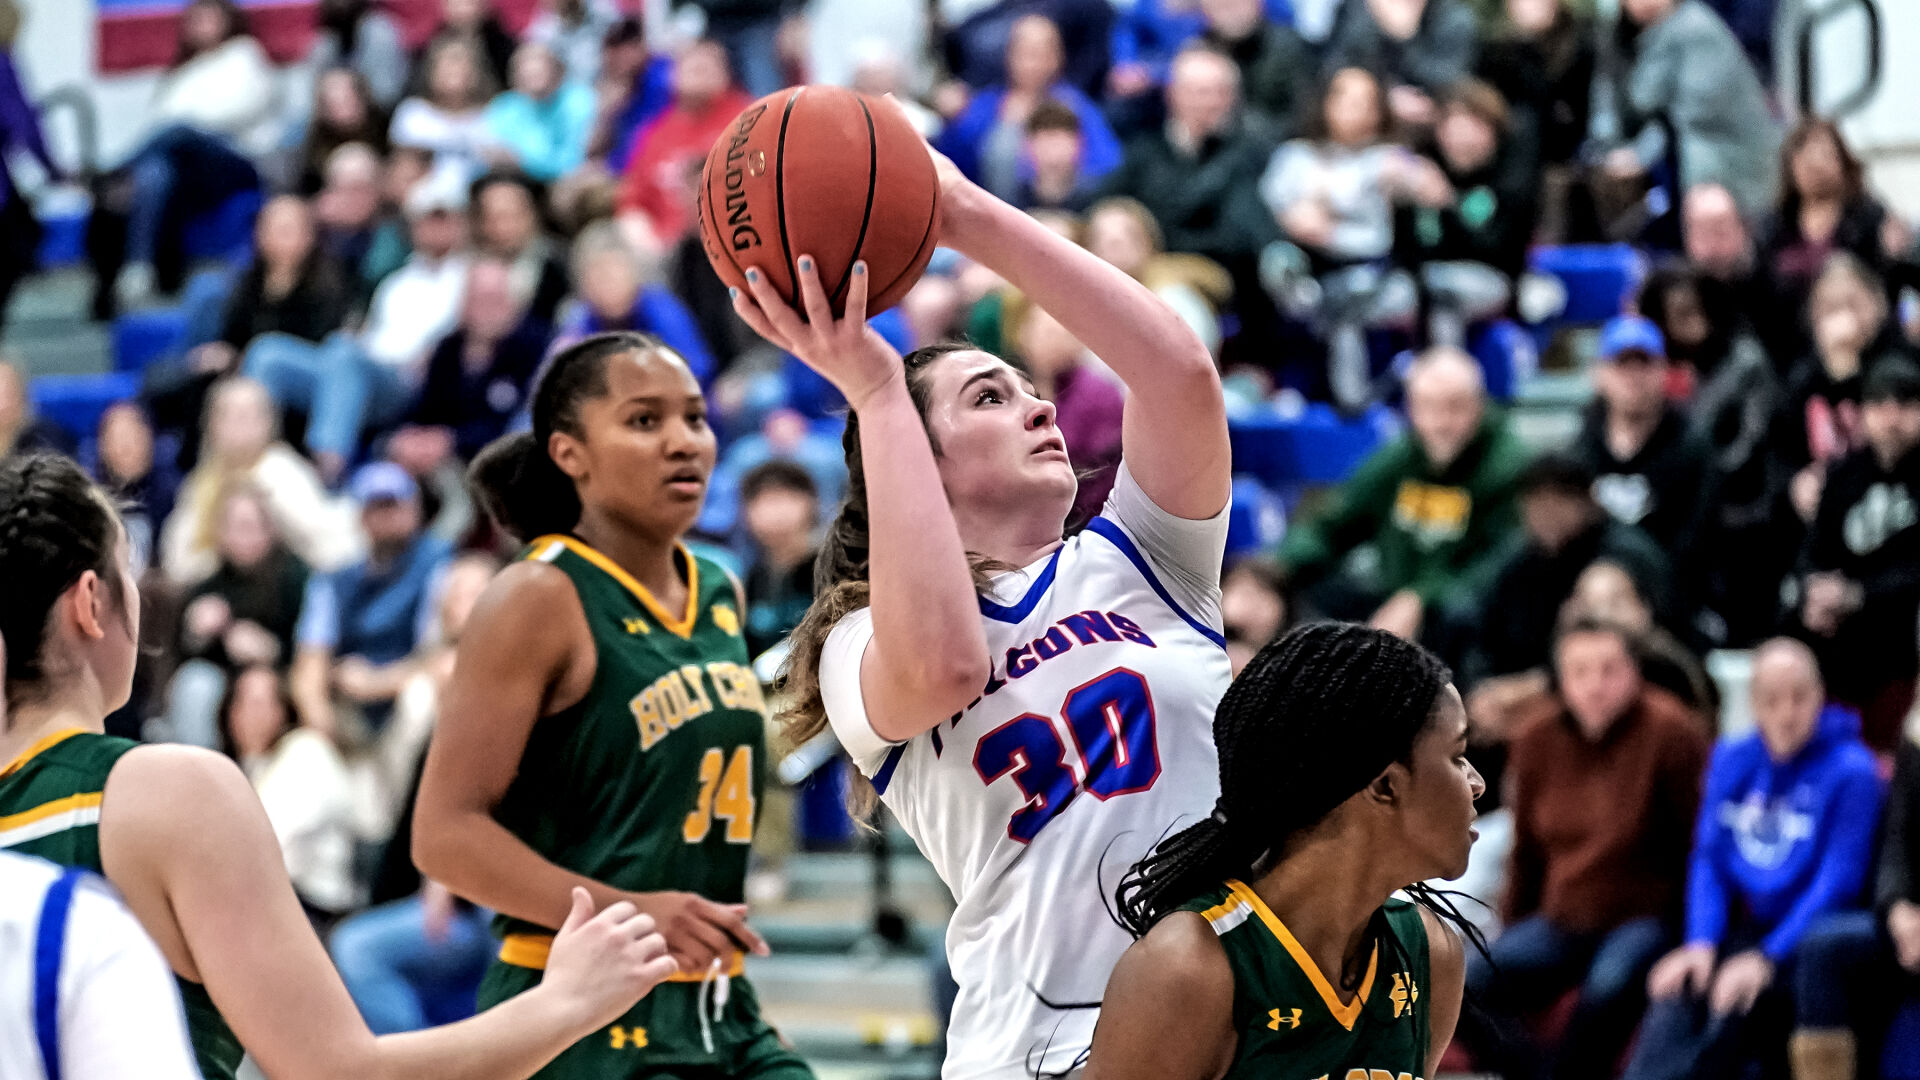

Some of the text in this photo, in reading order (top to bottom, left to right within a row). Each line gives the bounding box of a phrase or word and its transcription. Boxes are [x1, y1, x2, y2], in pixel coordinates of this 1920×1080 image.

[628, 663, 714, 752] HOLY
[931, 610, 1157, 760] CONS
[683, 745, 755, 844] 34
[972, 666, 1162, 844] 30
